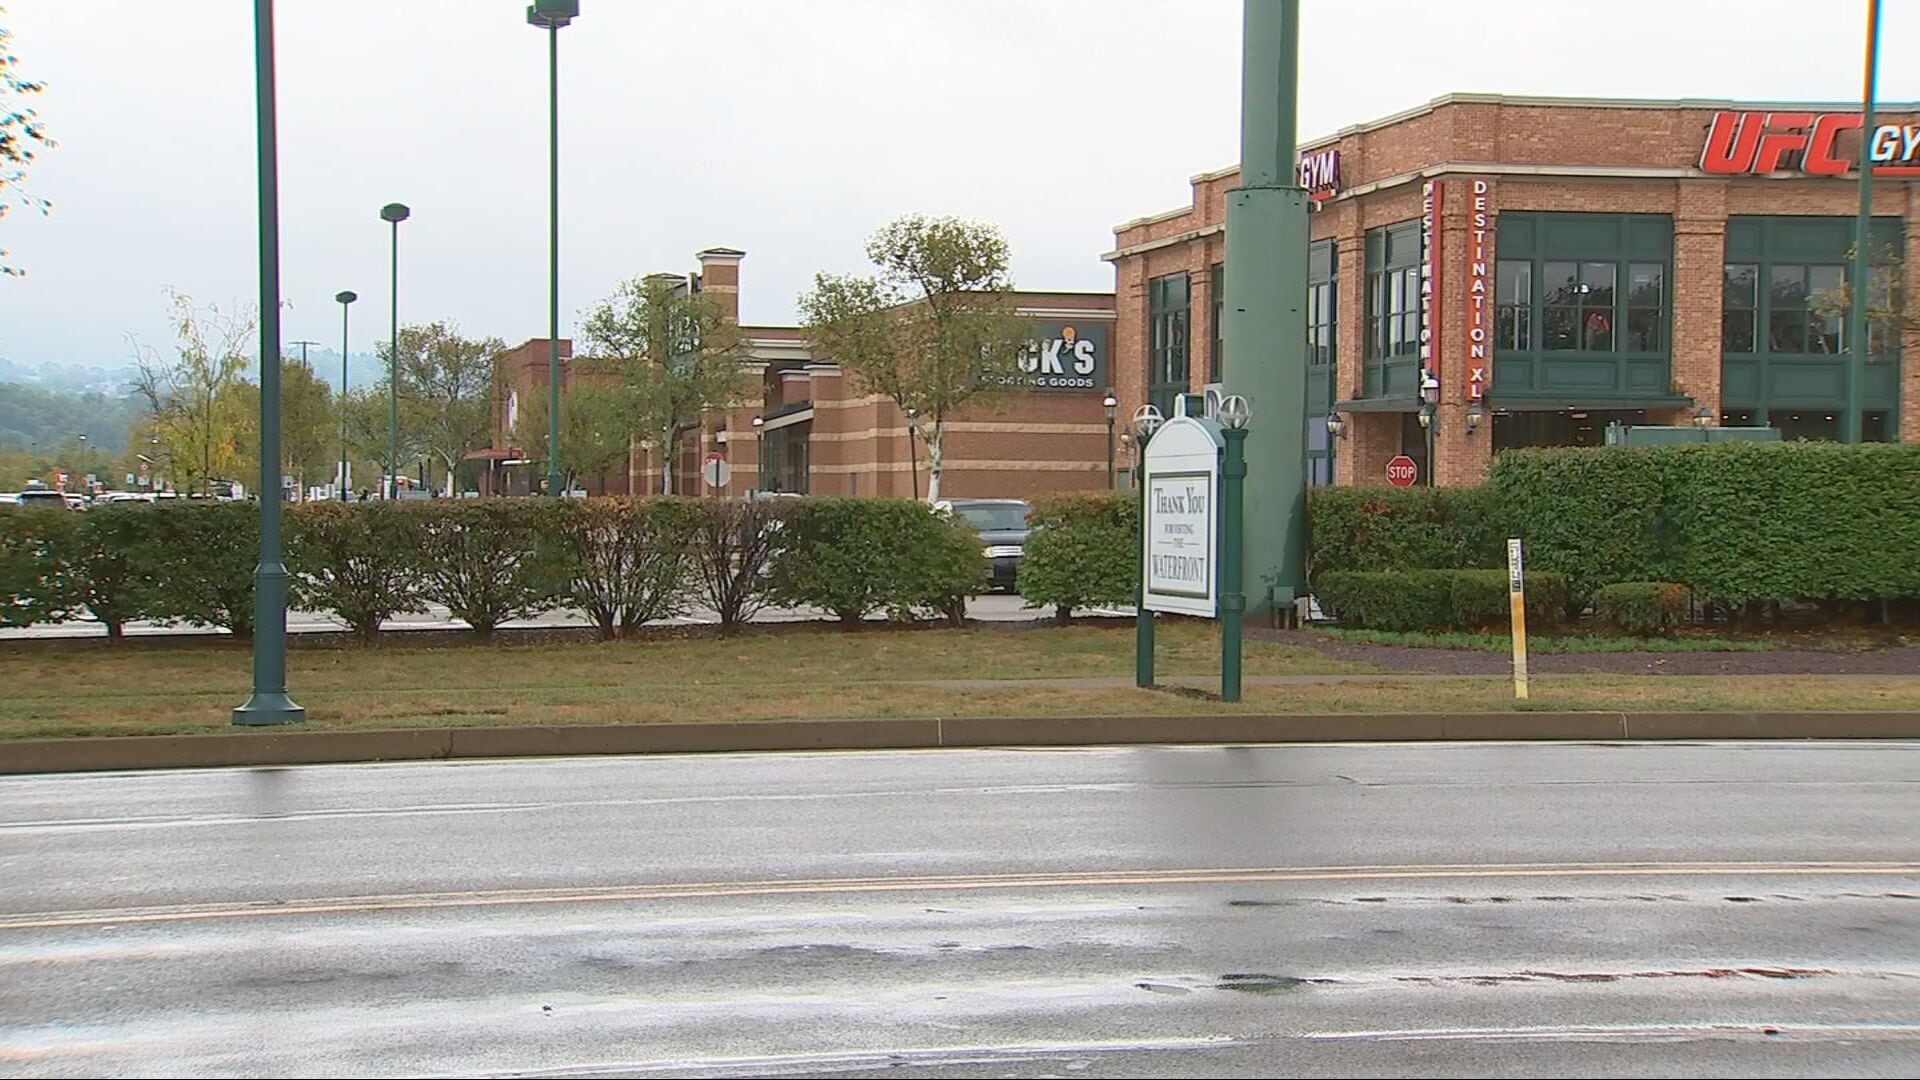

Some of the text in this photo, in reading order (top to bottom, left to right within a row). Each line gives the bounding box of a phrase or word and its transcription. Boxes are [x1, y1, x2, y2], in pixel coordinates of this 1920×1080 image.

[1699, 111, 1865, 175] UFC
[1300, 150, 1335, 190] GYM
[1420, 183, 1433, 359] DESTINATION
[1470, 181, 1487, 398] DESTINATION XL
[1049, 377, 1095, 388] GOODS
[1388, 466, 1414, 479] STOP
[1152, 554, 1205, 583] WATERFRONT
